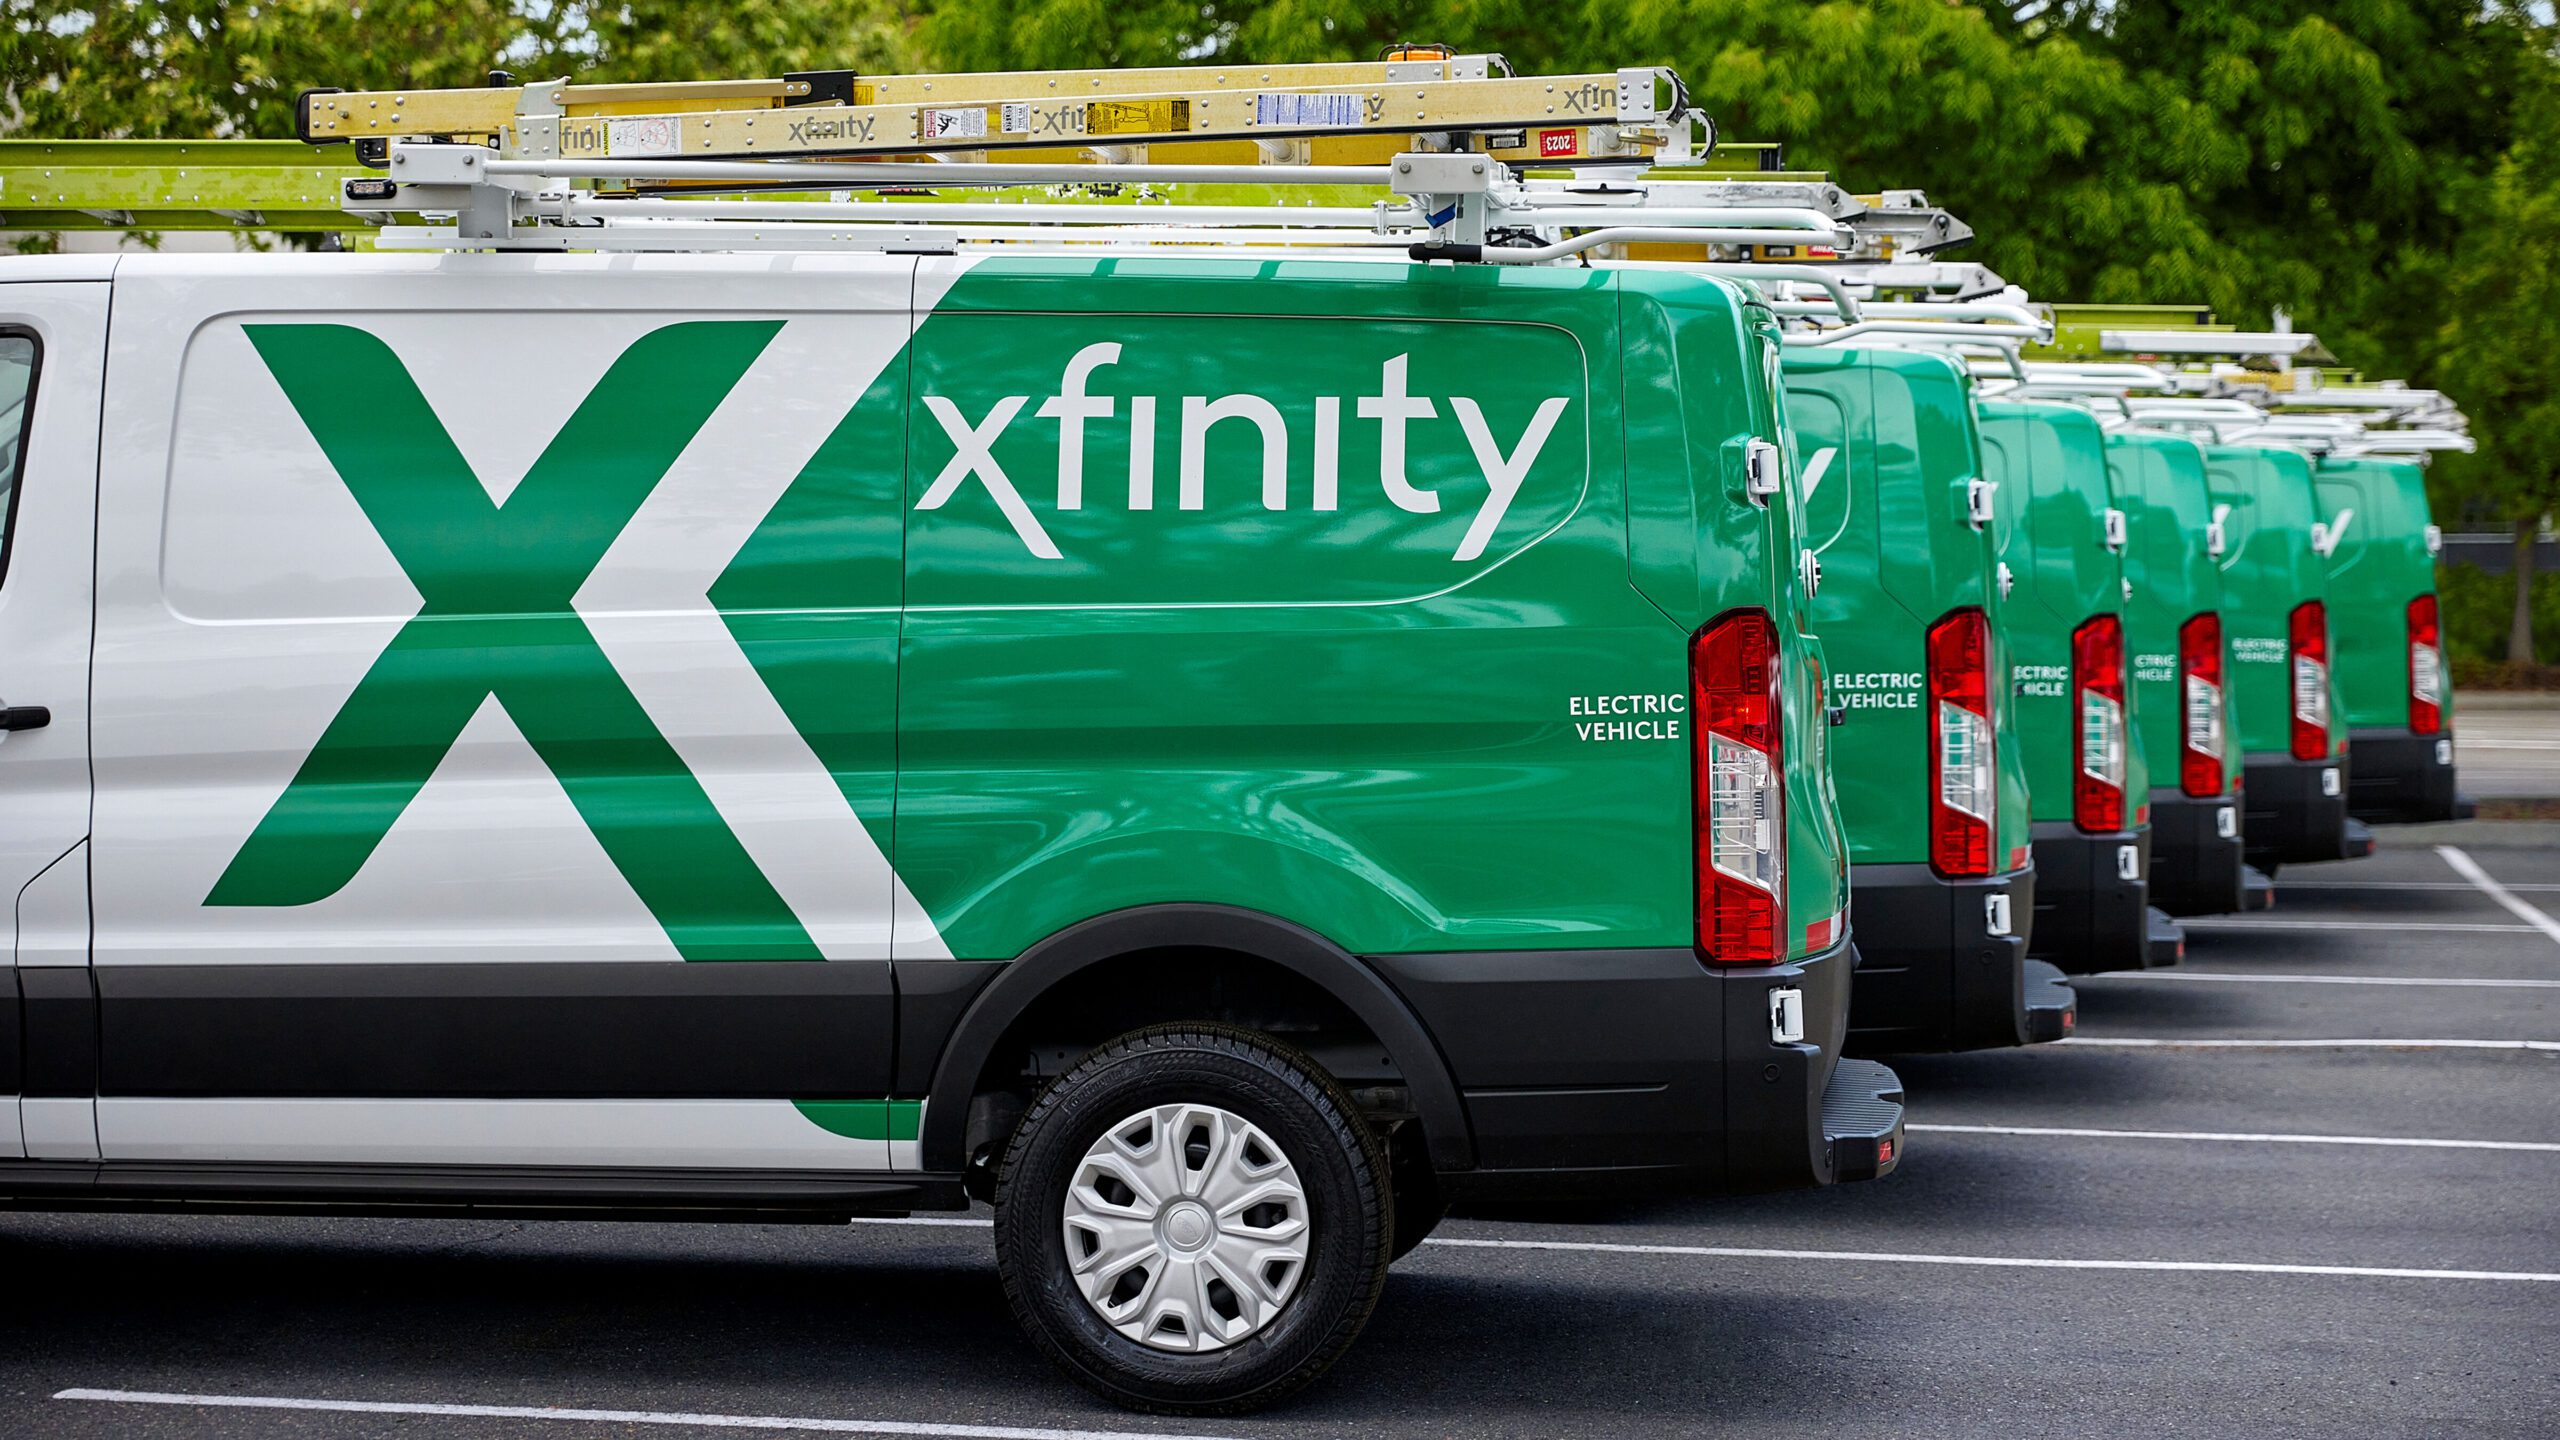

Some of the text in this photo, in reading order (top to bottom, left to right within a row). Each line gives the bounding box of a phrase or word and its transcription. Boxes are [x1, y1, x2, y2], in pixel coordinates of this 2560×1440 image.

[1564, 83, 1617, 114] xfin
[1546, 135, 1571, 151] 2023
[913, 341, 1570, 561] xfinity
[2134, 654, 2177, 668] CTRIC
[2014, 665, 2069, 680] ECTRIC
[2134, 668, 2172, 681] HICLE
[1834, 673, 1922, 689] ELECTRIC
[2023, 682, 2065, 696] HICLE
[1569, 694, 1685, 716] ELECTRIC
[1838, 692, 1918, 708] VEHICLE
[1575, 720, 1679, 741] VEHICLE
